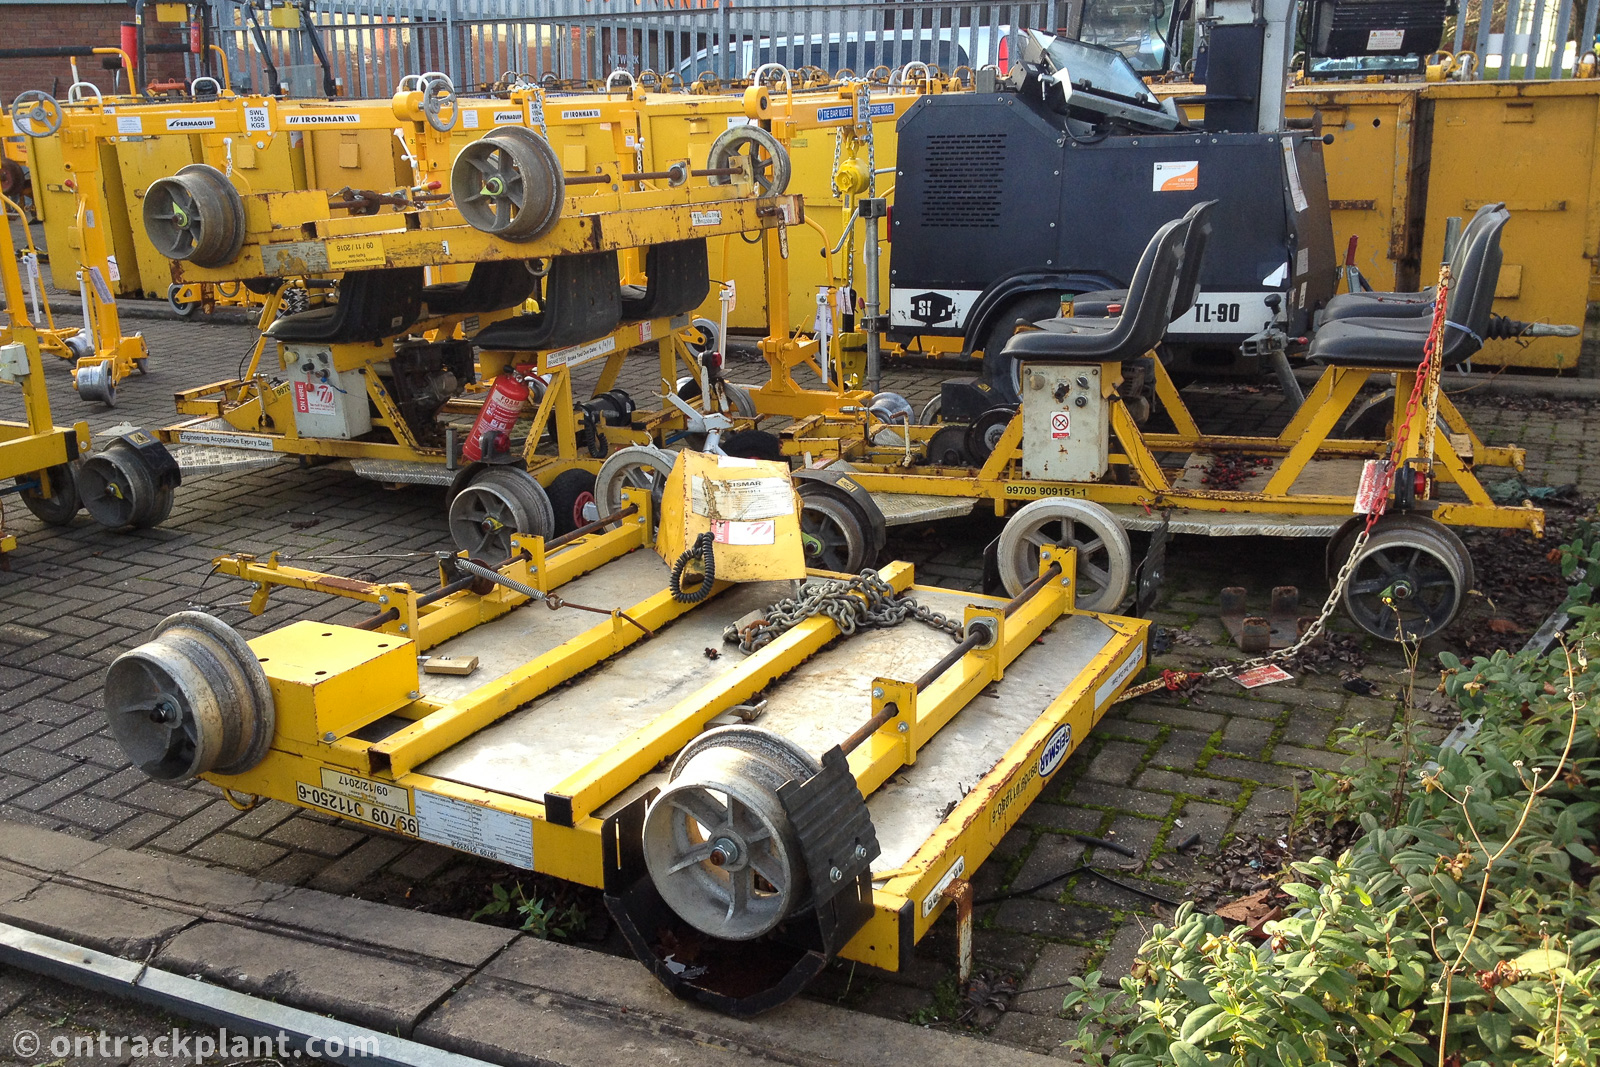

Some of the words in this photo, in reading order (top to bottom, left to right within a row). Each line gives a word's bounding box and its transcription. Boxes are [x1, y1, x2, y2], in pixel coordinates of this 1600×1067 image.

[301, 115, 345, 123] IRONMAN
[569, 110, 593, 118] IRONMAN
[176, 120, 214, 128] PERMAQUIP
[1194, 303, 1240, 323] TL-90
[300, 399, 306, 411] ON
[180, 434, 210, 443] Engineering
[210, 436, 240, 444] Acceptance
[1006, 485, 1037, 495] 99709
[1040, 486, 1086, 497] 909151-1
[1040, 726, 1071, 771] GEISMAR
[338, 775, 389, 796] 09/12/2017
[298, 784, 362, 817] 011250-6
[371, 809, 417, 833] 99709
